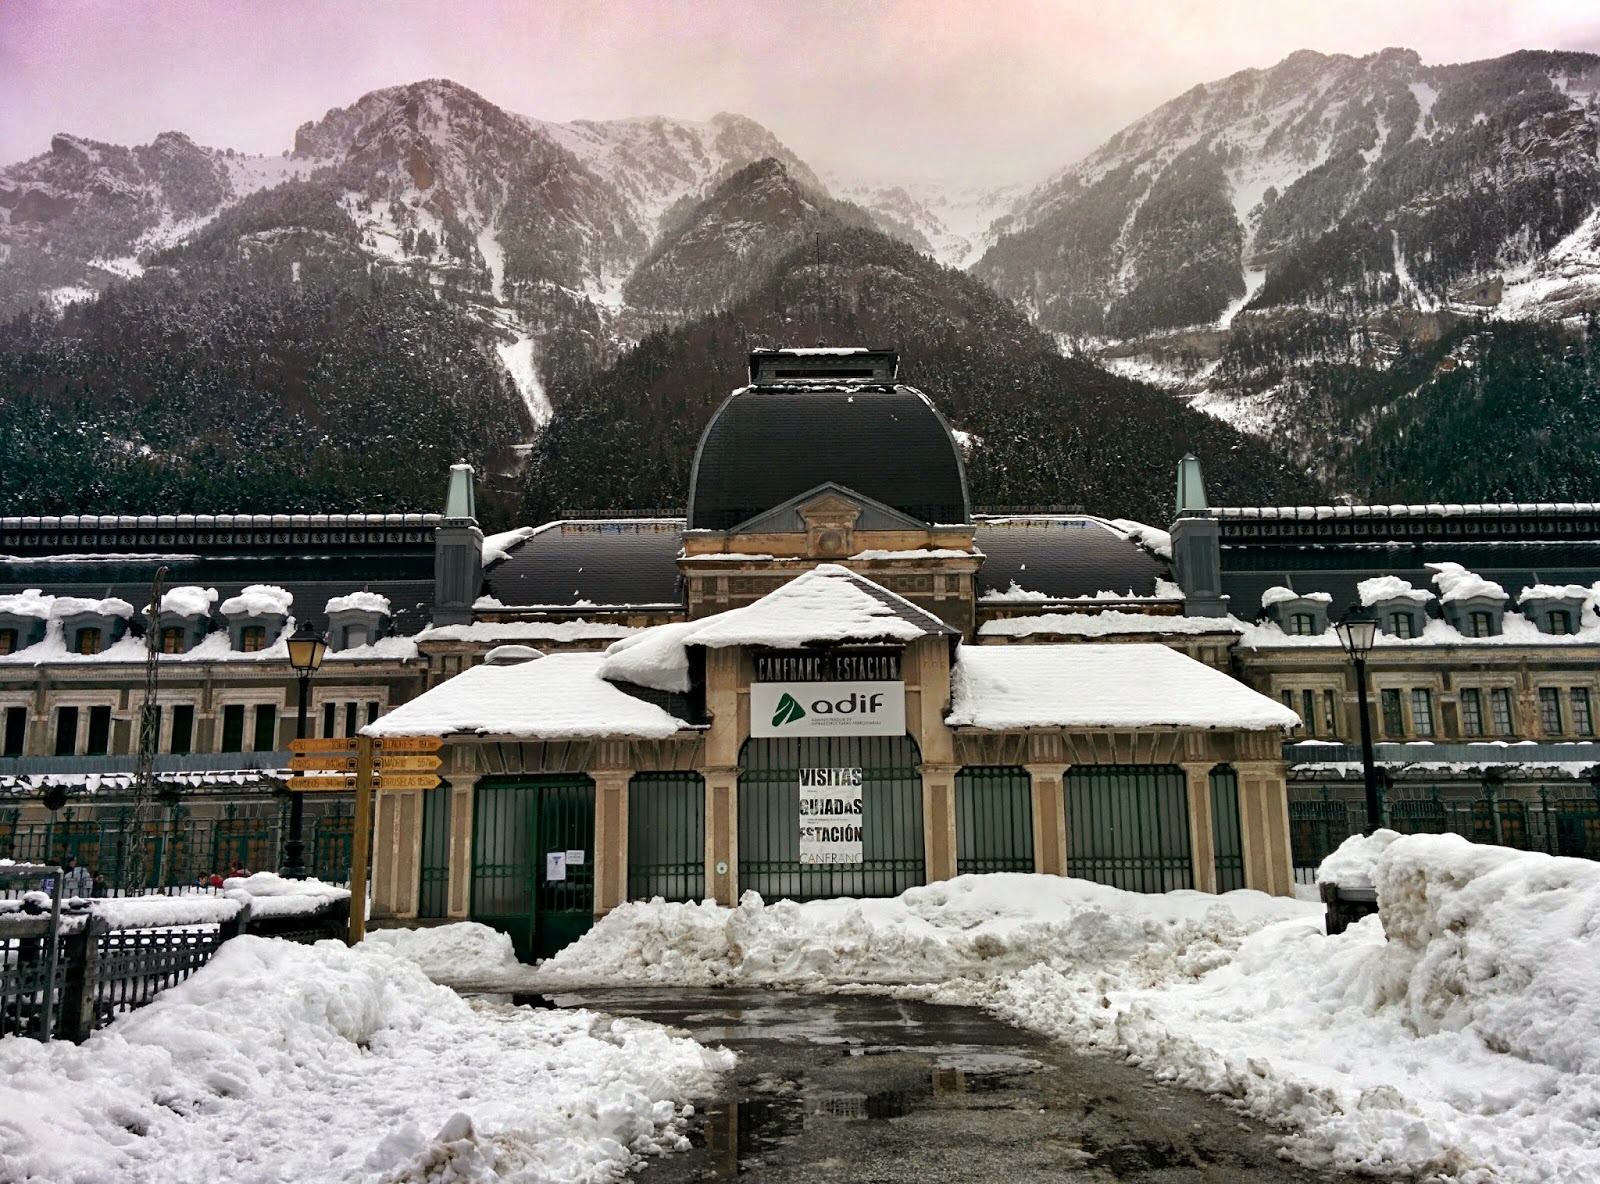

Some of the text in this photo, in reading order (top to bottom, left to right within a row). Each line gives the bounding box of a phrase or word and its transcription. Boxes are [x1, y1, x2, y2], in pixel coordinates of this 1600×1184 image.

[759, 656, 897, 681] CANFRANC ESTACION
[811, 692, 884, 714] adif
[384, 739, 413, 749] LONDRES
[292, 759, 311, 769] PARIS
[384, 758, 407, 768] MADRID
[383, 777, 417, 787] BRUSELAS
[799, 768, 863, 787] VISITAS
[799, 798, 863, 816] GUIADAS
[799, 823, 863, 843] ESTACIÓN
[799, 852, 863, 864] CANFRANC
